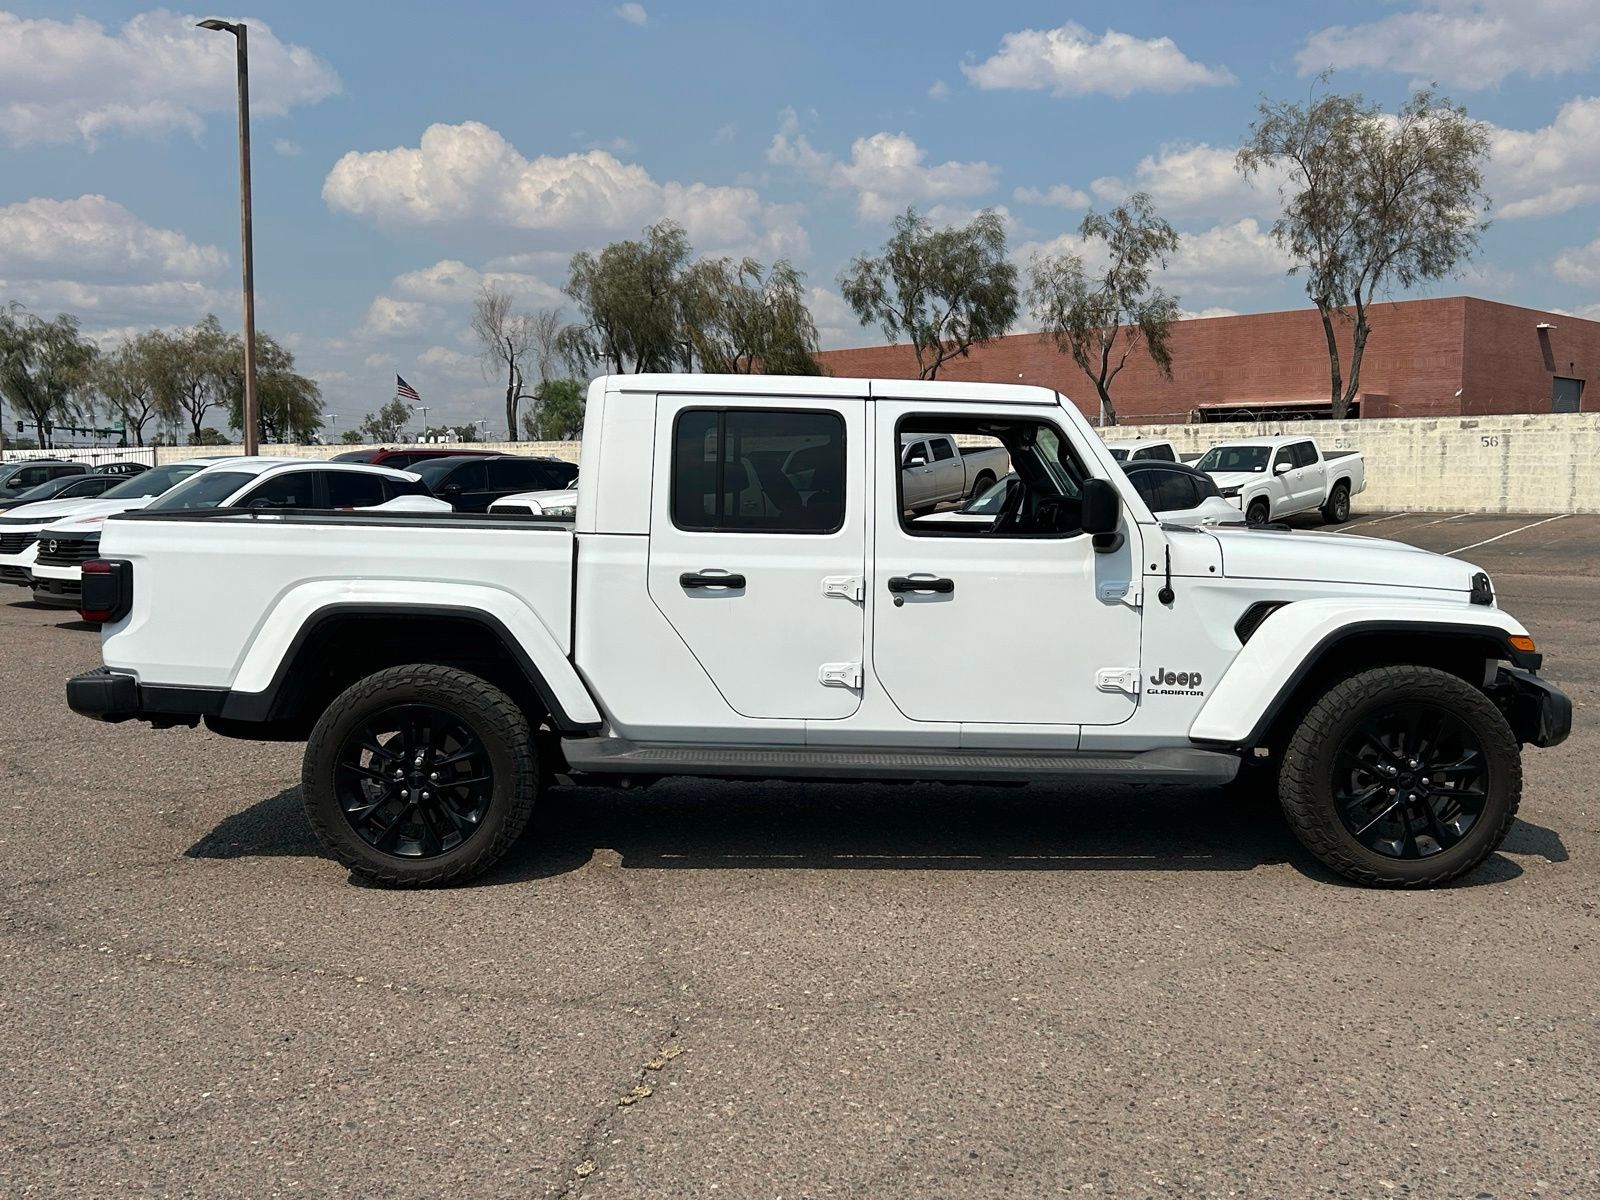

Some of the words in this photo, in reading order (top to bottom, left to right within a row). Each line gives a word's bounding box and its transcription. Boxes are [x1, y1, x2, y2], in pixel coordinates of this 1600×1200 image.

[1481, 436, 1498, 447] 56
[1150, 667, 1202, 689] Jeep
[1147, 688, 1204, 696] GLADIATOR
